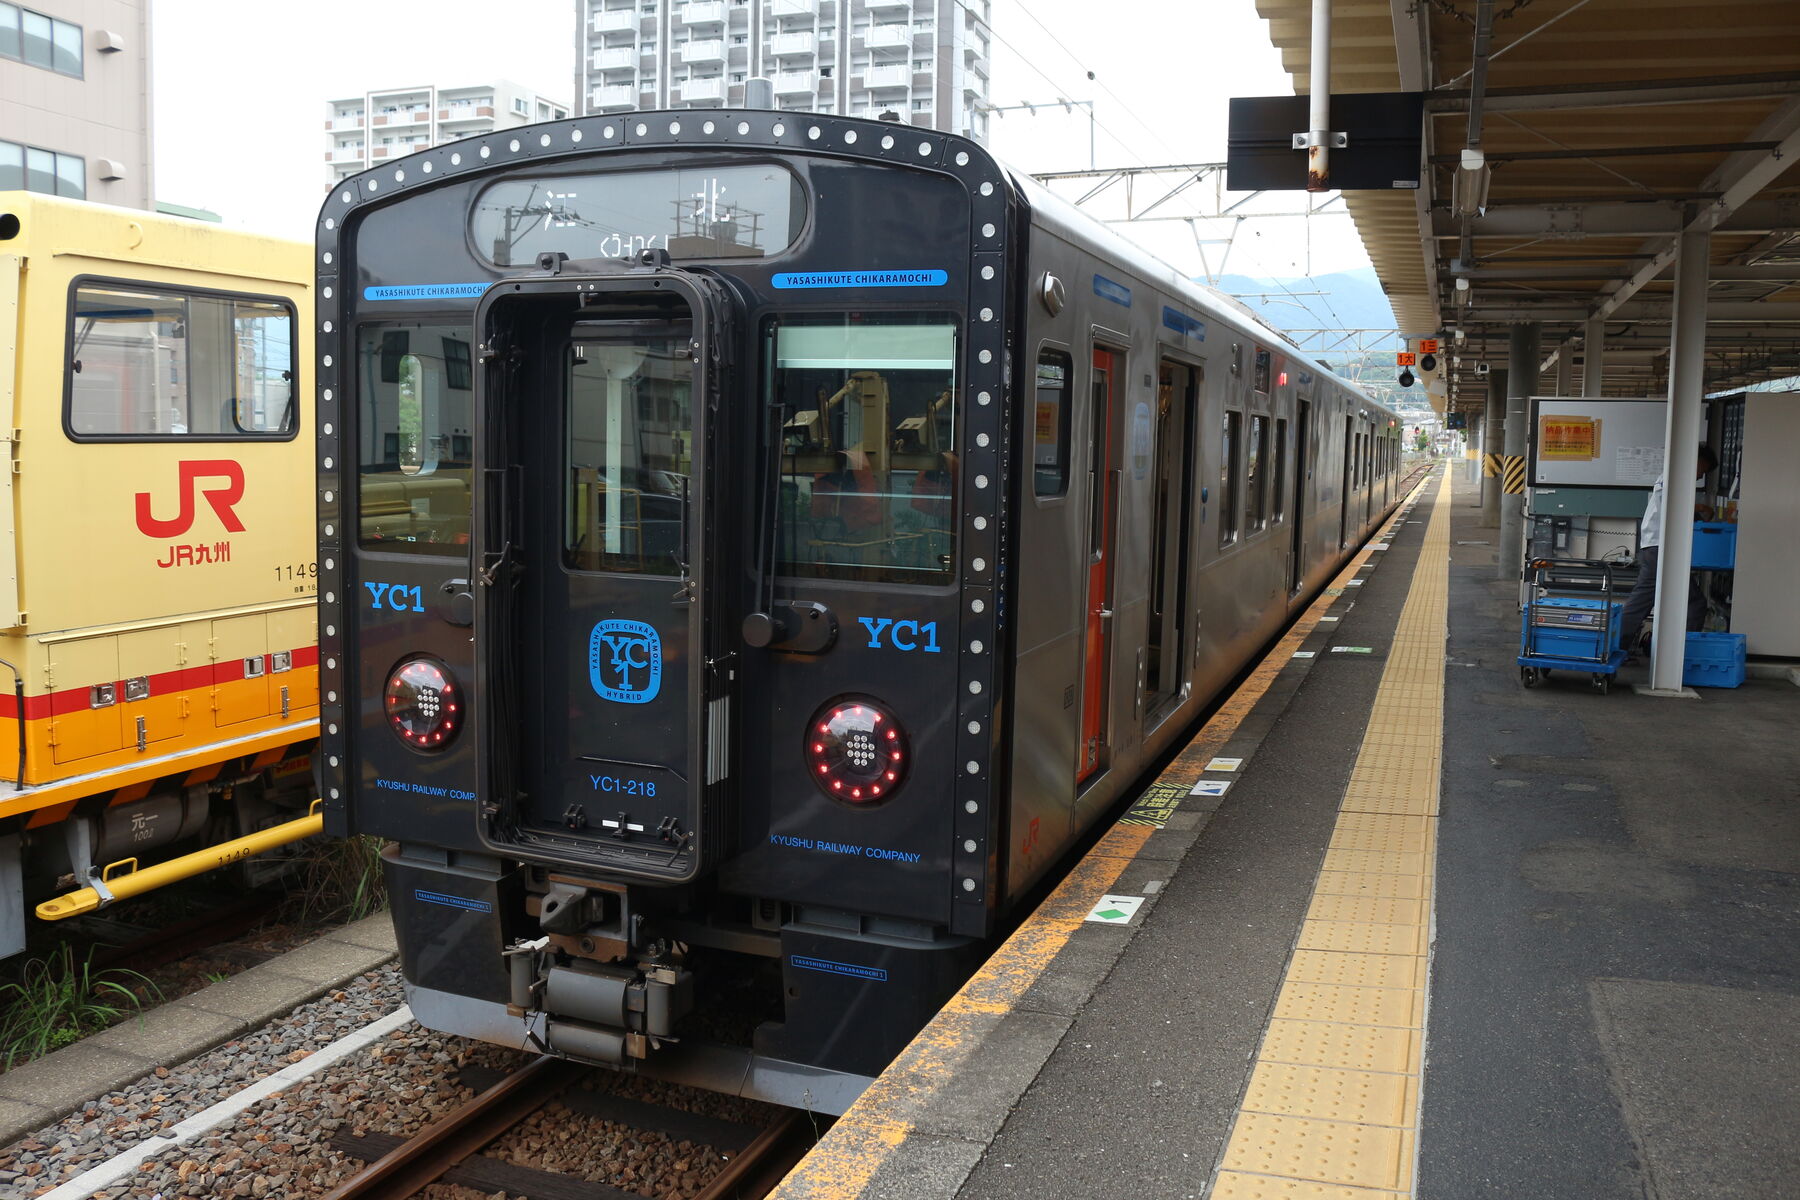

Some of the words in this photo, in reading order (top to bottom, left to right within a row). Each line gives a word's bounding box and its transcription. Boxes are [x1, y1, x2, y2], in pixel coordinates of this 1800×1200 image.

[375, 288, 425, 297] YASASHIKUTE
[427, 286, 486, 296] CHIKARAMOCHI
[787, 275, 852, 285] YASASHIKUTE
[855, 274, 933, 284] CHIKARAMOCHI
[135, 459, 246, 538] JR
[156, 541, 231, 568] JR九州
[275, 562, 318, 581] 1149
[364, 581, 425, 612] YC1
[858, 616, 941, 652] YC1
[592, 623, 620, 670] YASASHIKUTE
[623, 623, 659, 676] CHIKARAMOCHI
[606, 690, 642, 701] HYBRID
[377, 779, 410, 792] KYUSHU
[412, 784, 447, 797] RAILWAY
[449, 789, 477, 801] COMP
[590, 774, 656, 797] YC1-218
[770, 834, 814, 849] KYUSHU
[816, 840, 862, 856] RAILWAY
[865, 847, 920, 863] COMPANY
